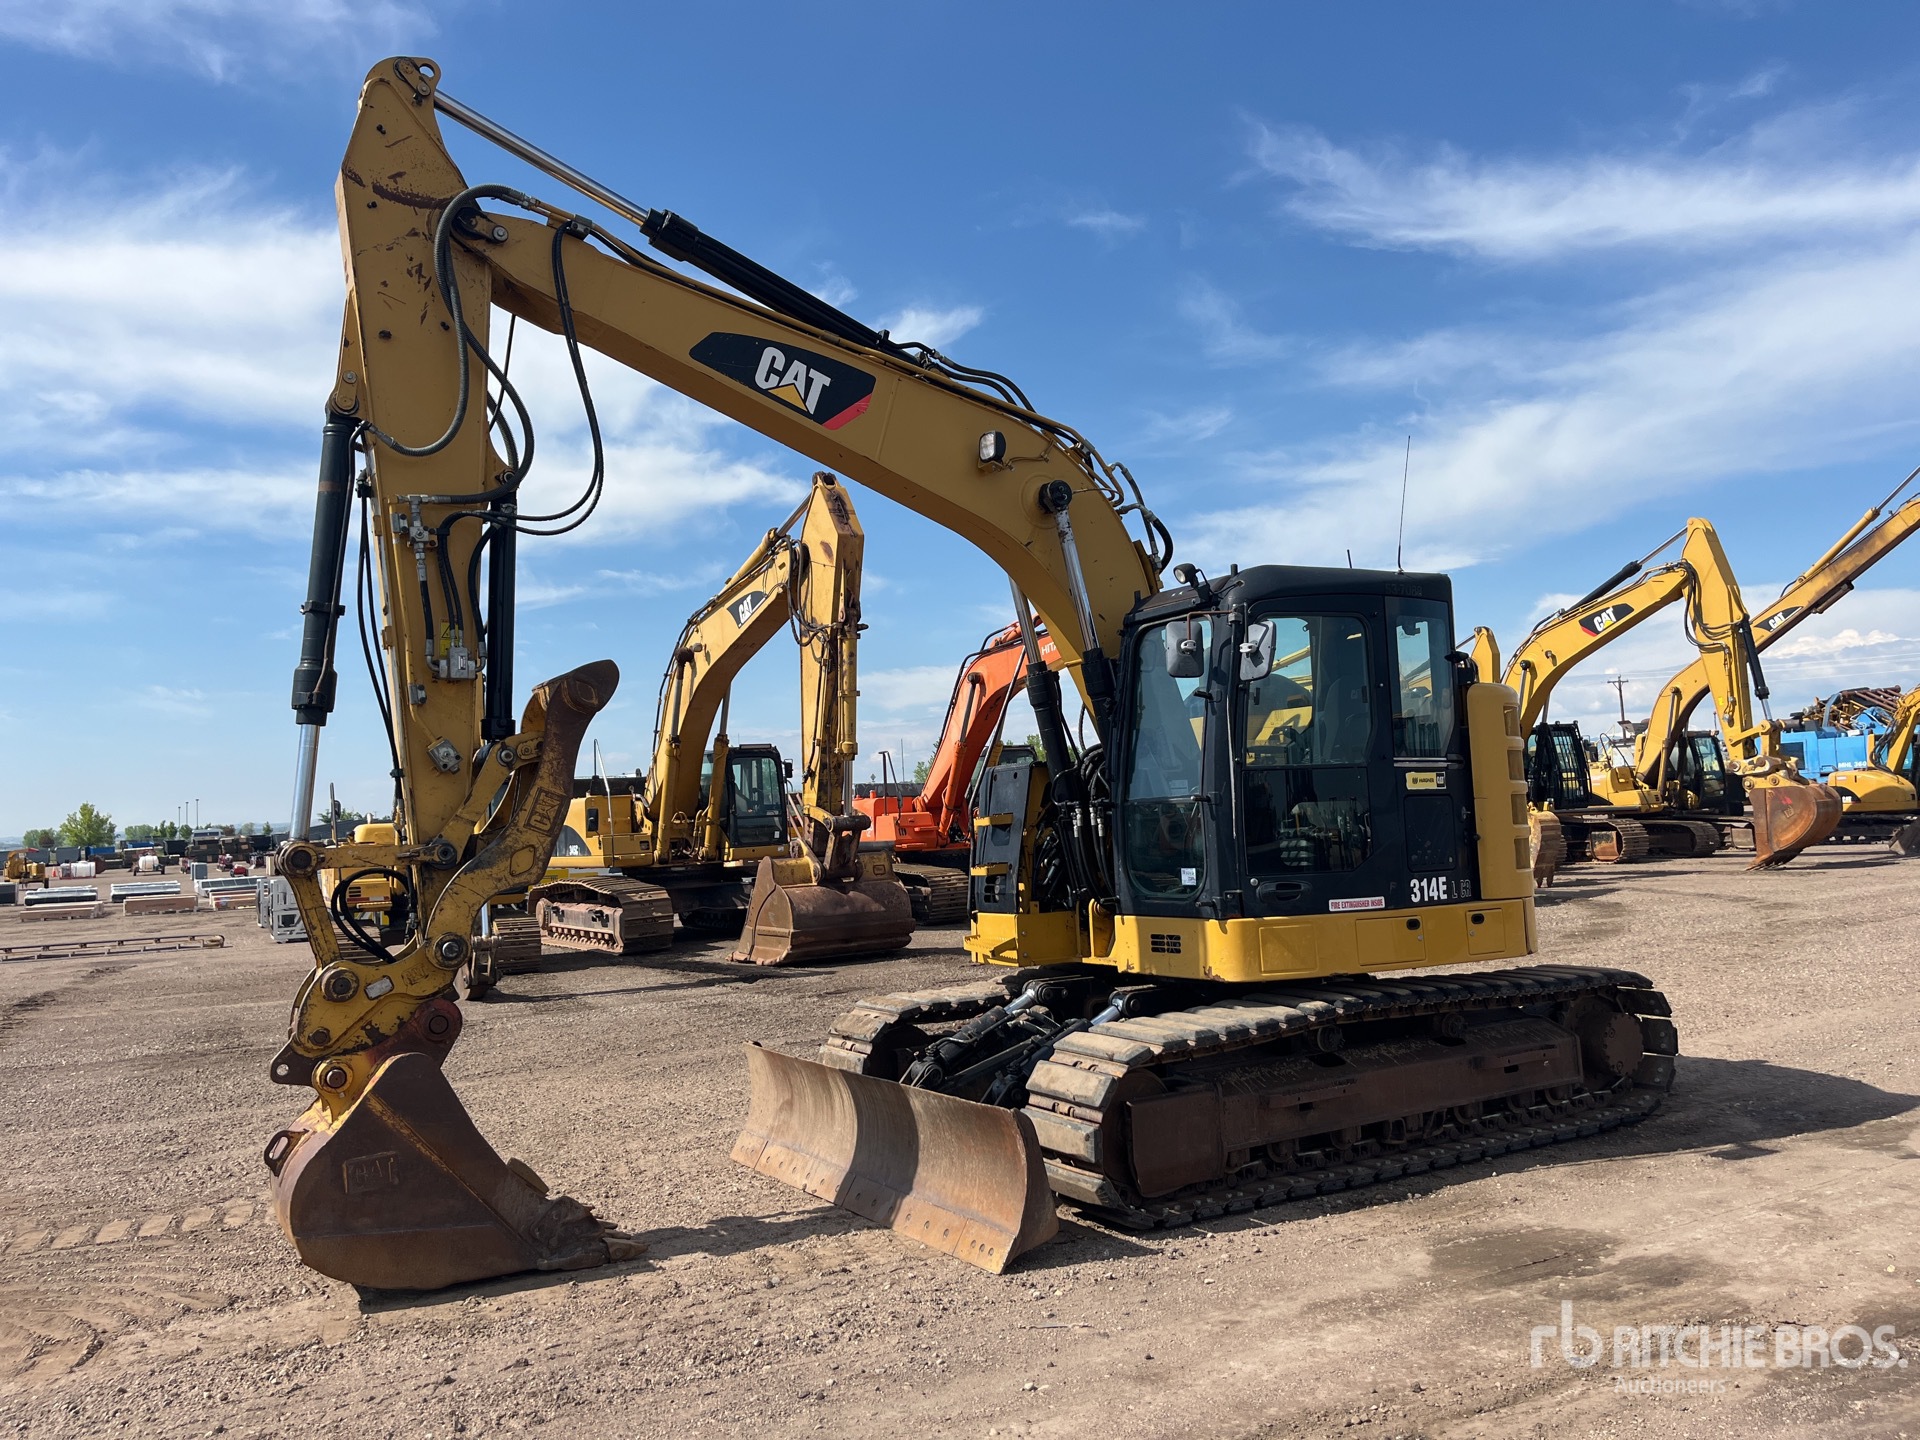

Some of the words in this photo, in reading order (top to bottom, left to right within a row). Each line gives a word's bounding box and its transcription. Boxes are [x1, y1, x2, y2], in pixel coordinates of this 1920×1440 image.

[755, 346, 831, 415] CAT
[739, 594, 753, 624] CAT
[1594, 606, 1617, 632] CAT
[1769, 612, 1786, 629] CAT
[1410, 876, 1448, 903] 314E
[1451, 880, 1459, 899] L
[1331, 901, 1341, 910] FIRE
[1341, 899, 1370, 909] EXTINGUISHER
[1370, 898, 1383, 907] INSIDE
